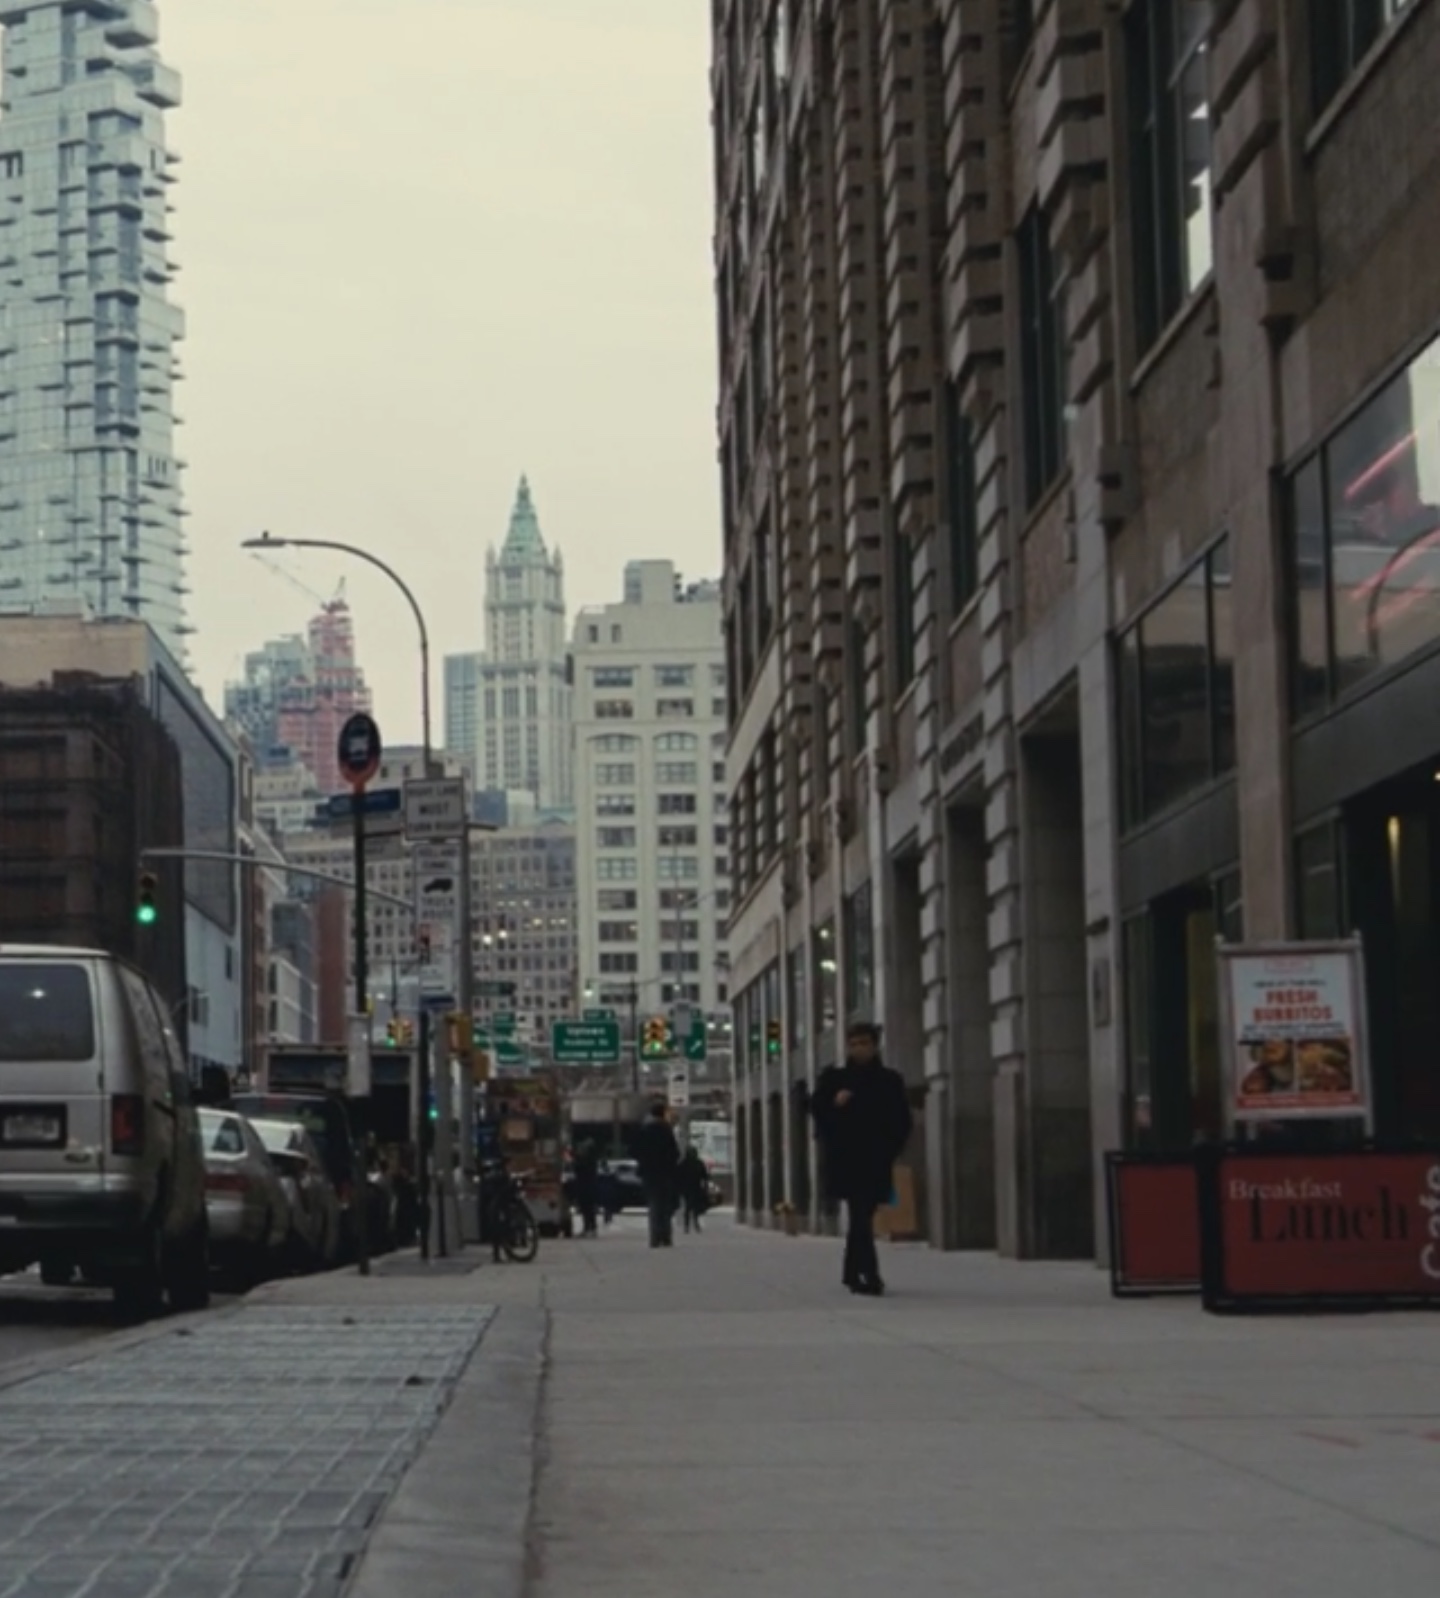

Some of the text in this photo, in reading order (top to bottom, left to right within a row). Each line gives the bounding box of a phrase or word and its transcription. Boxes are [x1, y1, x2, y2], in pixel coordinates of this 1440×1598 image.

[419, 801, 449, 815] MUST
[421, 897, 455, 907] TRUCK
[1266, 989, 1318, 1004] FRESH
[1253, 1005, 1334, 1022] BURRITOS
[566, 1027, 606, 1037] Uptown
[1229, 1178, 1342, 1199] Breakfast
[1251, 1185, 1408, 1242] Lunch
